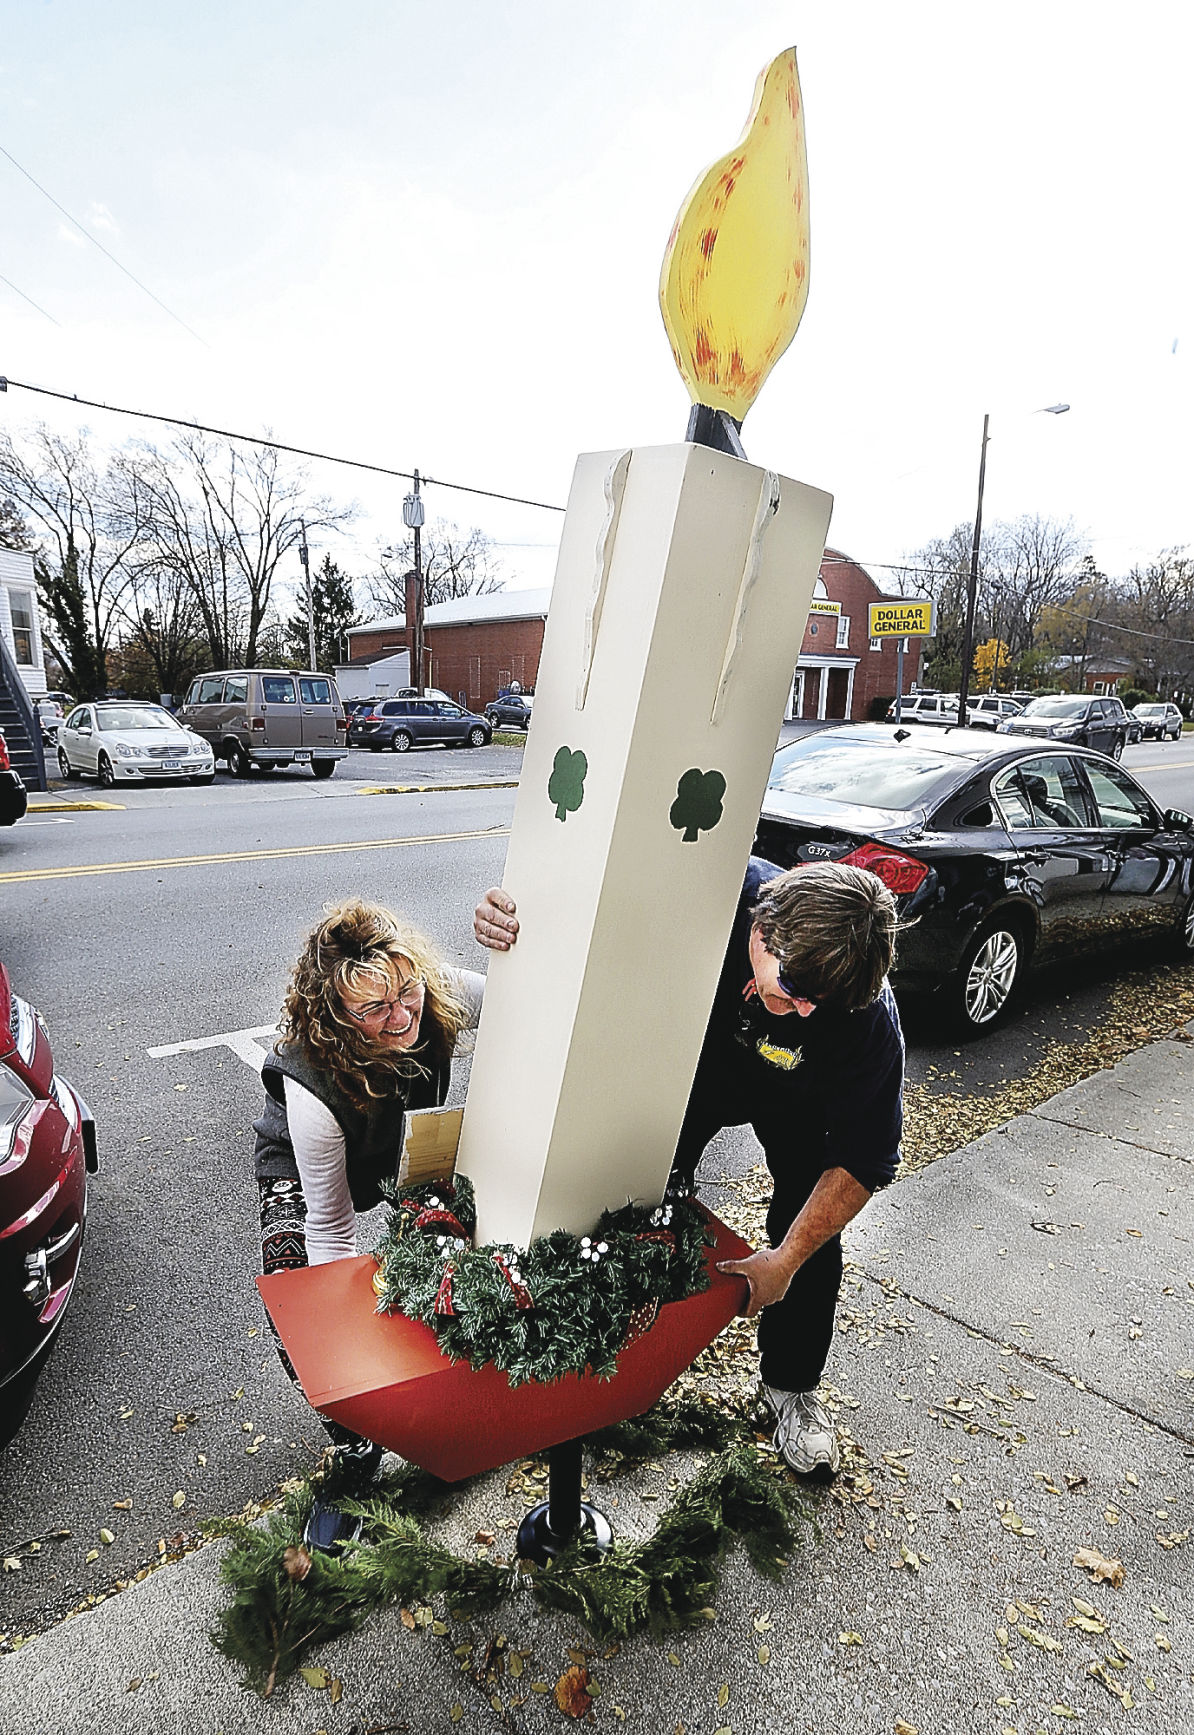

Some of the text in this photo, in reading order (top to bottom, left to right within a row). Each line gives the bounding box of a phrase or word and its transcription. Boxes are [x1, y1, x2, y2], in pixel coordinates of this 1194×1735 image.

[818, 604, 838, 612] GENERAL
[877, 609, 923, 620] DOLLAR
[874, 620, 926, 632] GENERAL
